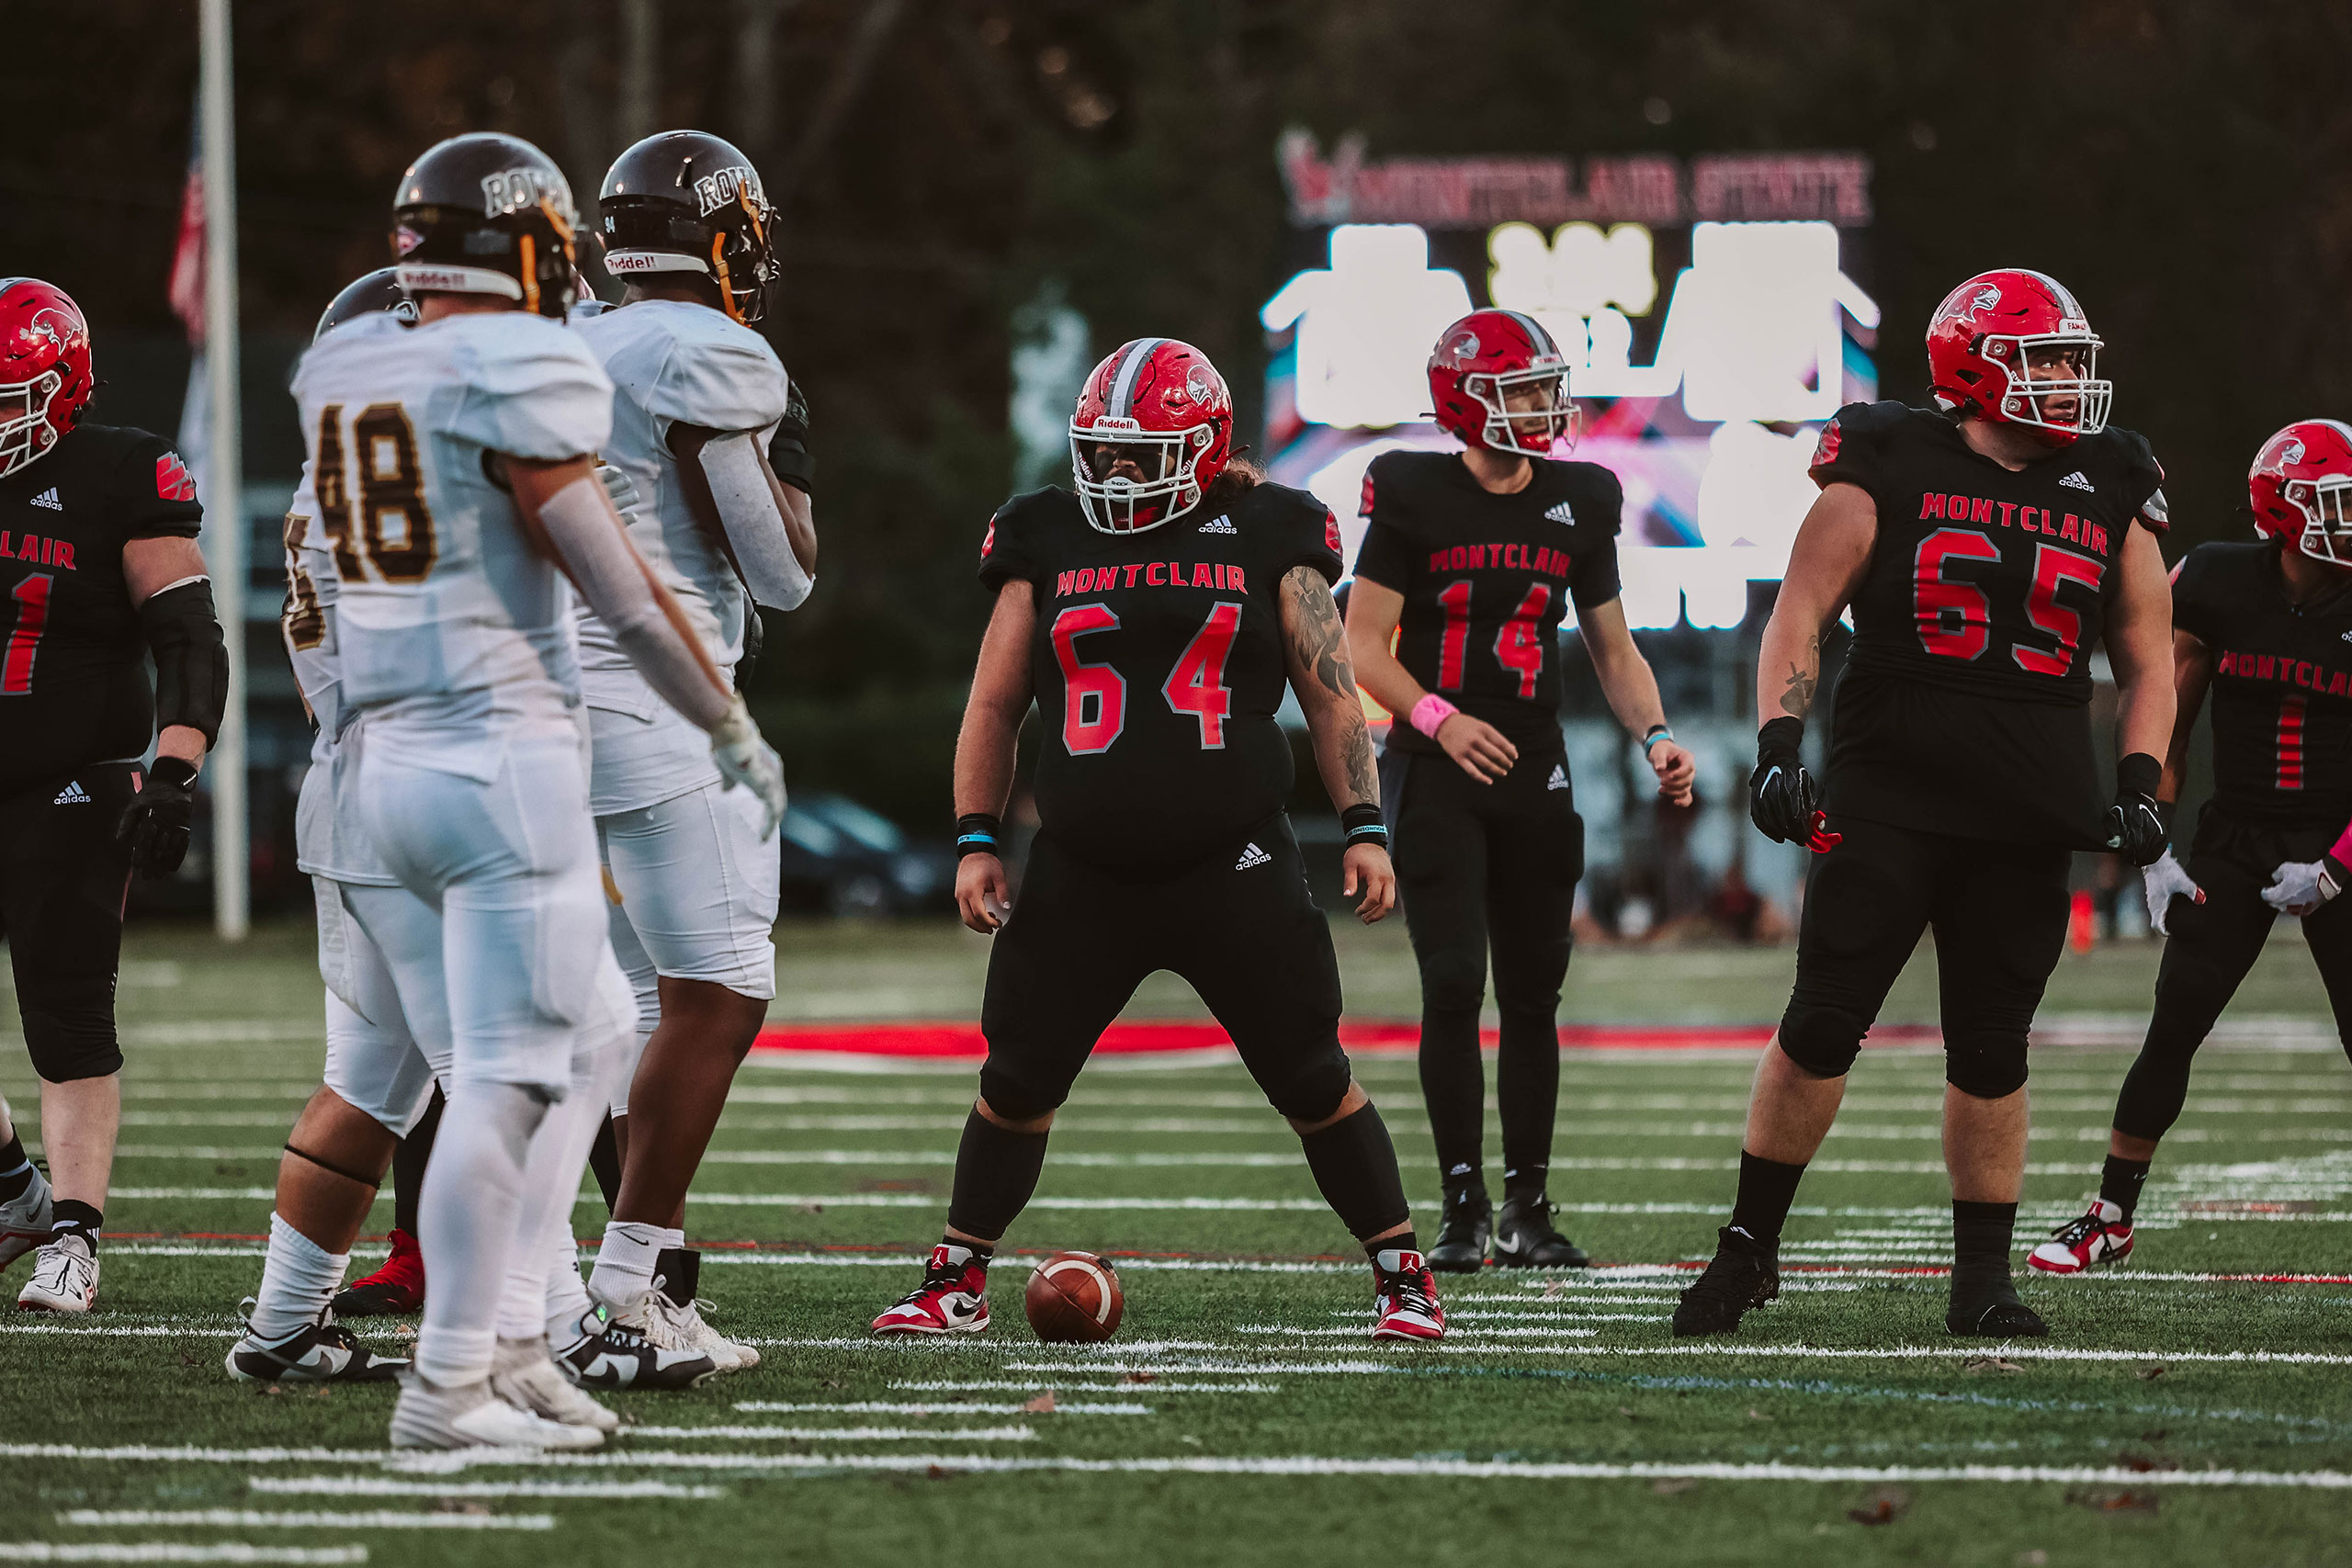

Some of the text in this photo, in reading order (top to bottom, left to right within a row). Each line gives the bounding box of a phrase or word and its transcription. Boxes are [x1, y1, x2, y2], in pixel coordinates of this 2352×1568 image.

[1097, 419, 1134, 430] Riddell
[2058, 478, 2096, 493] adidas
[29, 497, 63, 512] adidas
[1197, 525, 1238, 535] adidas
[1918, 491, 2109, 557] MONTCLAIR
[1430, 543, 1572, 578] MONTCLAIR
[1054, 561, 1250, 599] MONTCLAIR
[1913, 526, 2107, 678] 65
[1437, 580, 1552, 698] 14
[1049, 601, 1243, 757] 64
[2275, 694, 2308, 791] 1
[53, 795, 91, 806] adidas
[1235, 852, 1272, 871] adidas
